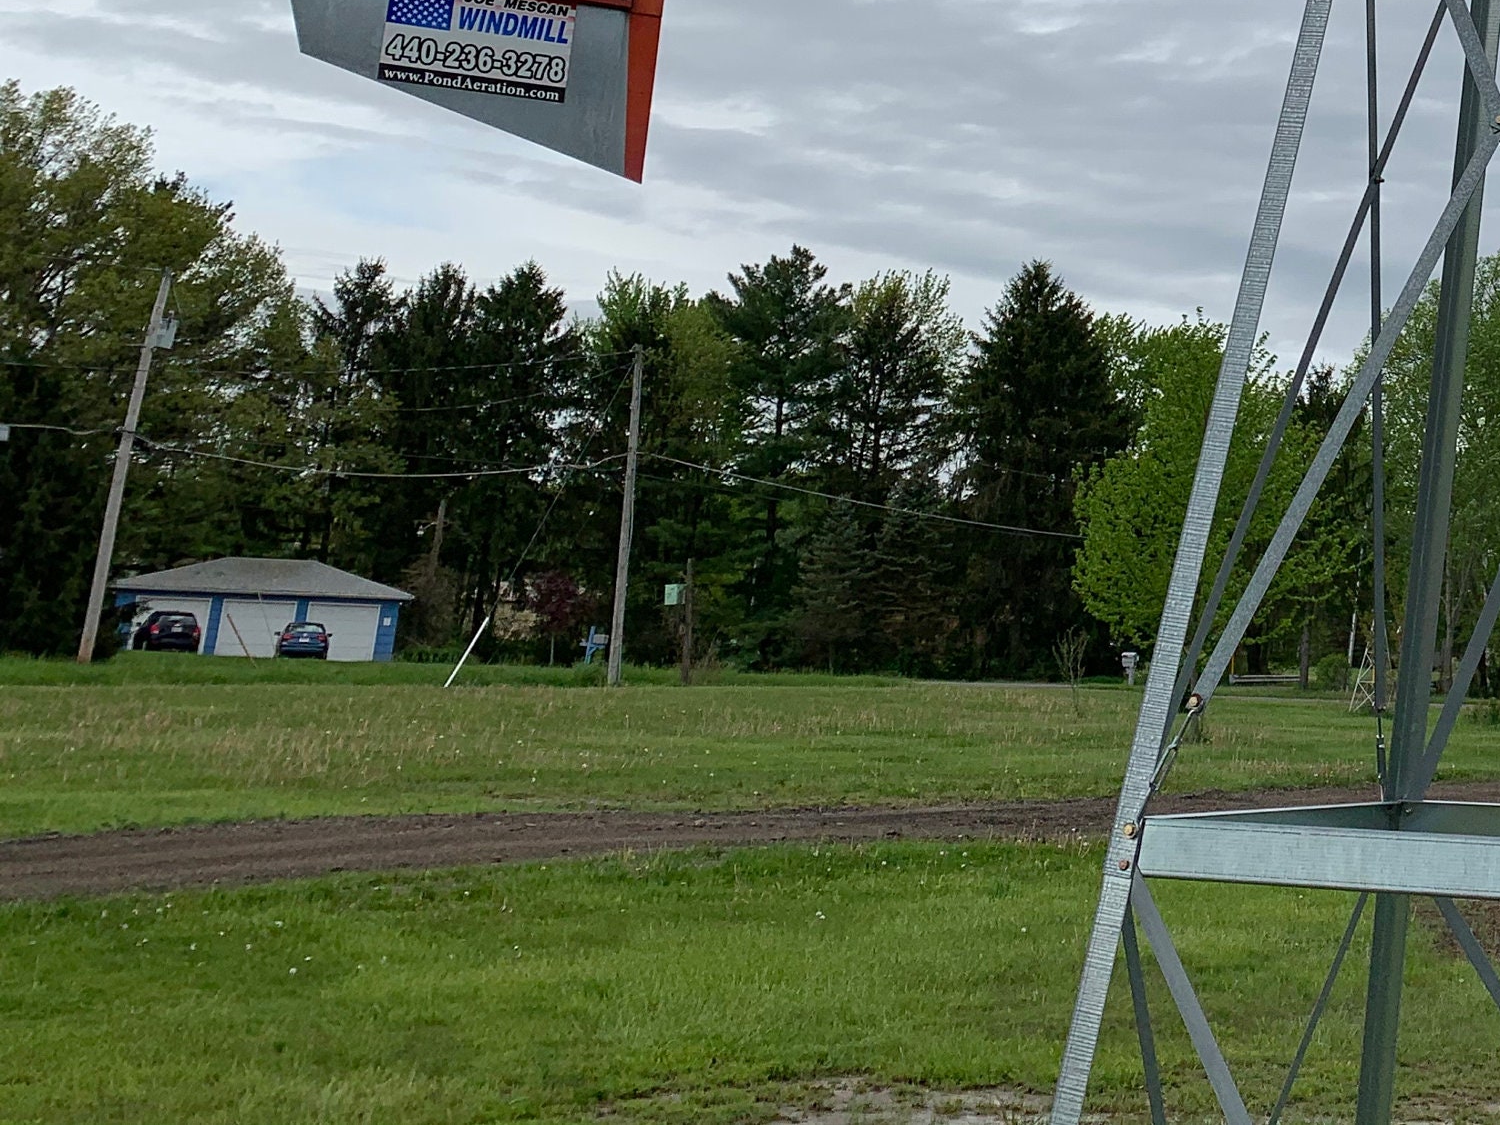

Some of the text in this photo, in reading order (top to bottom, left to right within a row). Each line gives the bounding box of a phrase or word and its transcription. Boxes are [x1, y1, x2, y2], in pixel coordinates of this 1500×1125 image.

[458, 6, 568, 44] WINDMILL
[385, 33, 566, 82] 440-236-3278
[384, 68, 559, 101] www.PondAeration.com
